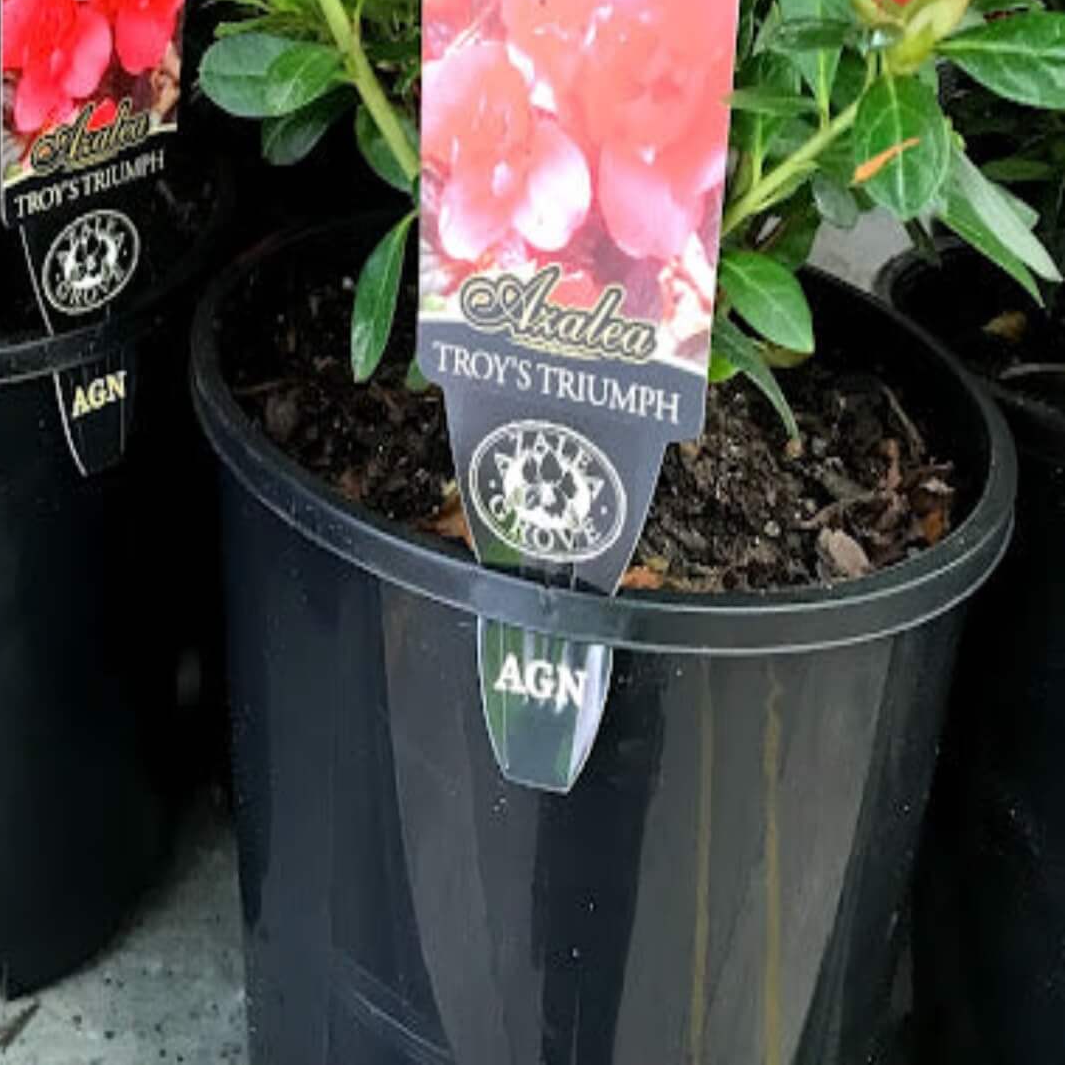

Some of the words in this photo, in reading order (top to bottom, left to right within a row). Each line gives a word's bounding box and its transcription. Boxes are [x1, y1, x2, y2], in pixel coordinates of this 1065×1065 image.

[30, 97, 151, 175] Azalea
[14, 181, 79, 218] TROY'S
[82, 148, 164, 195] TRIUMPH
[459, 264, 657, 362] Azalea
[72, 370, 127, 419] AGN
[434, 342, 532, 390] TROY'S
[536, 363, 681, 424] TRIUMPH
[488, 494, 602, 551] GROVE
[494, 652, 588, 708] AGN
